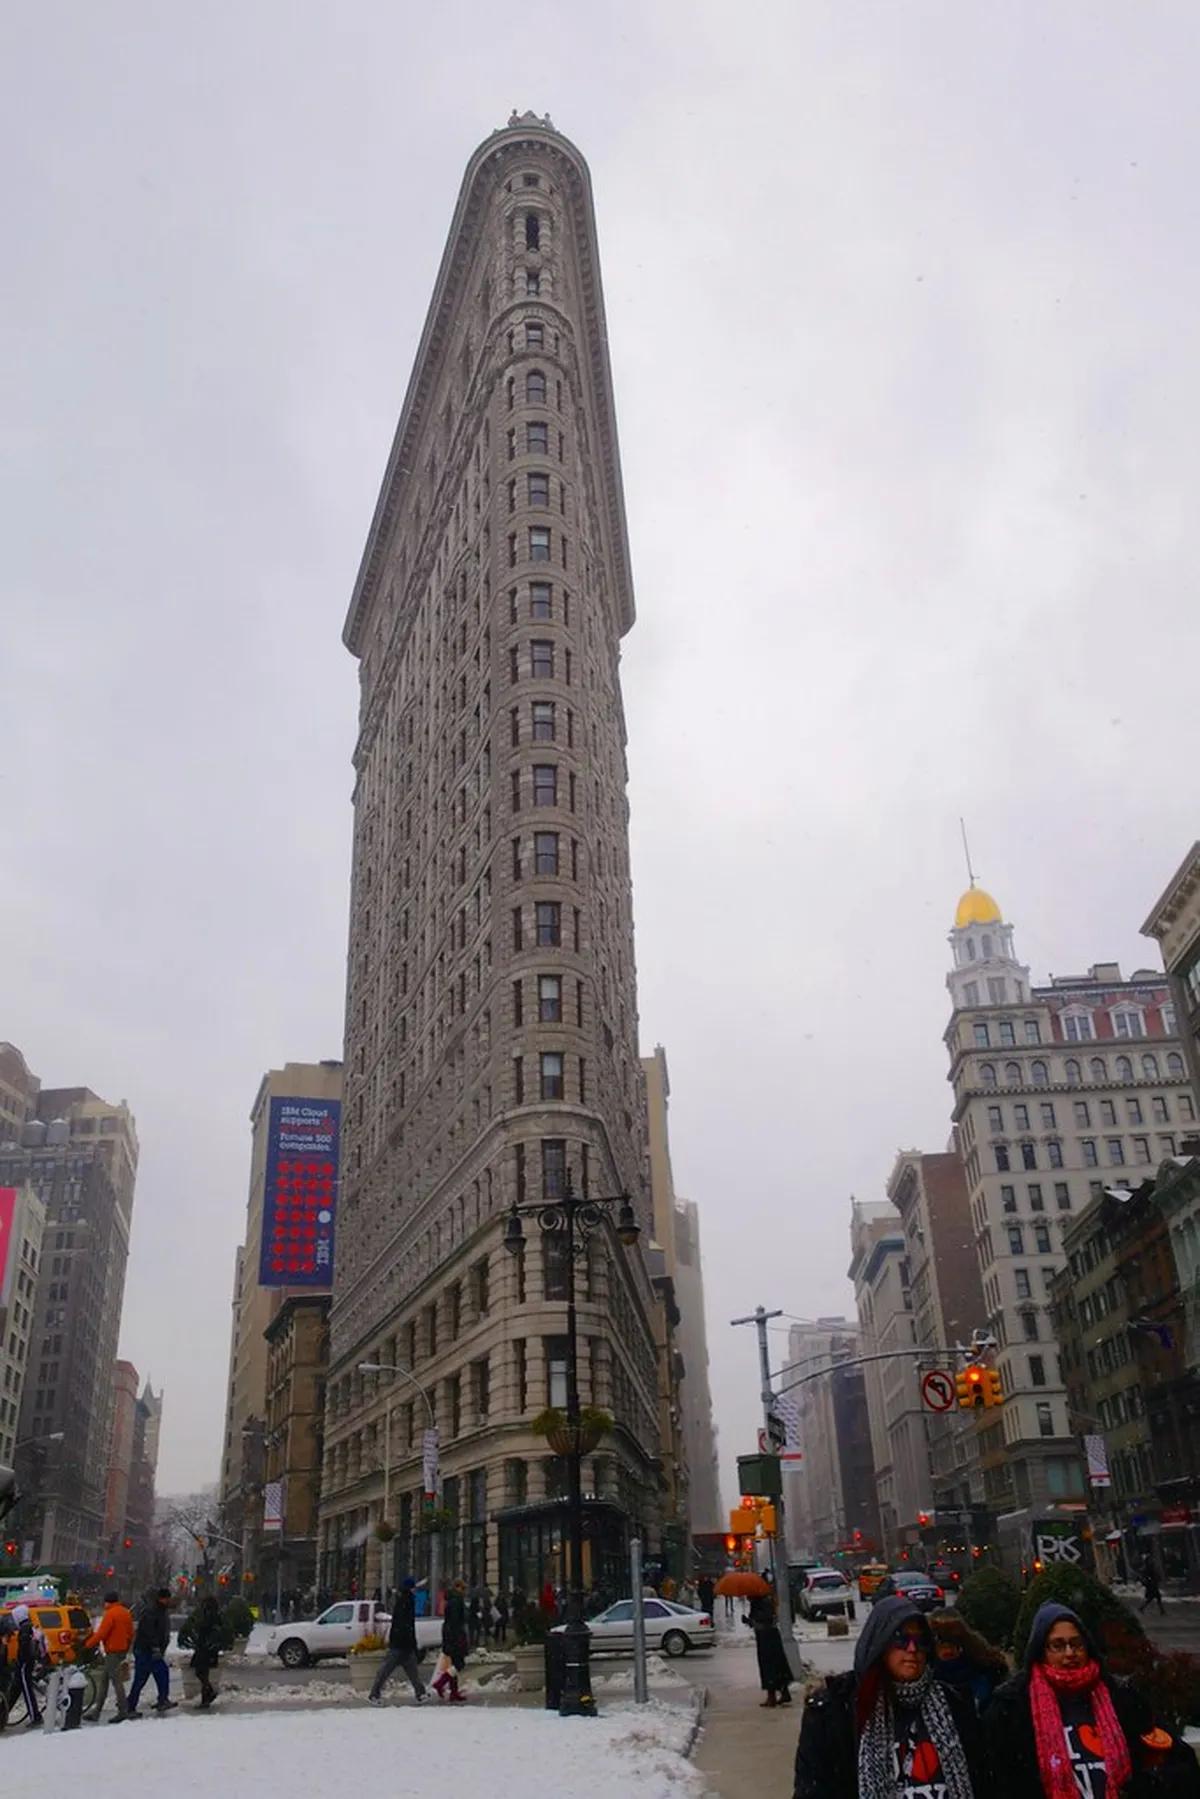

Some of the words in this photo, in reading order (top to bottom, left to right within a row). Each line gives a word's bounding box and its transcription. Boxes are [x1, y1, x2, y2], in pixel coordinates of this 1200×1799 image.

[281, 1106, 299, 1116] IBM
[300, 1107, 328, 1117] Cloud
[280, 1117, 320, 1126] supports
[280, 1133, 313, 1142] Fortune
[315, 1135, 332, 1143] 500
[316, 1240, 330, 1265] IBM
